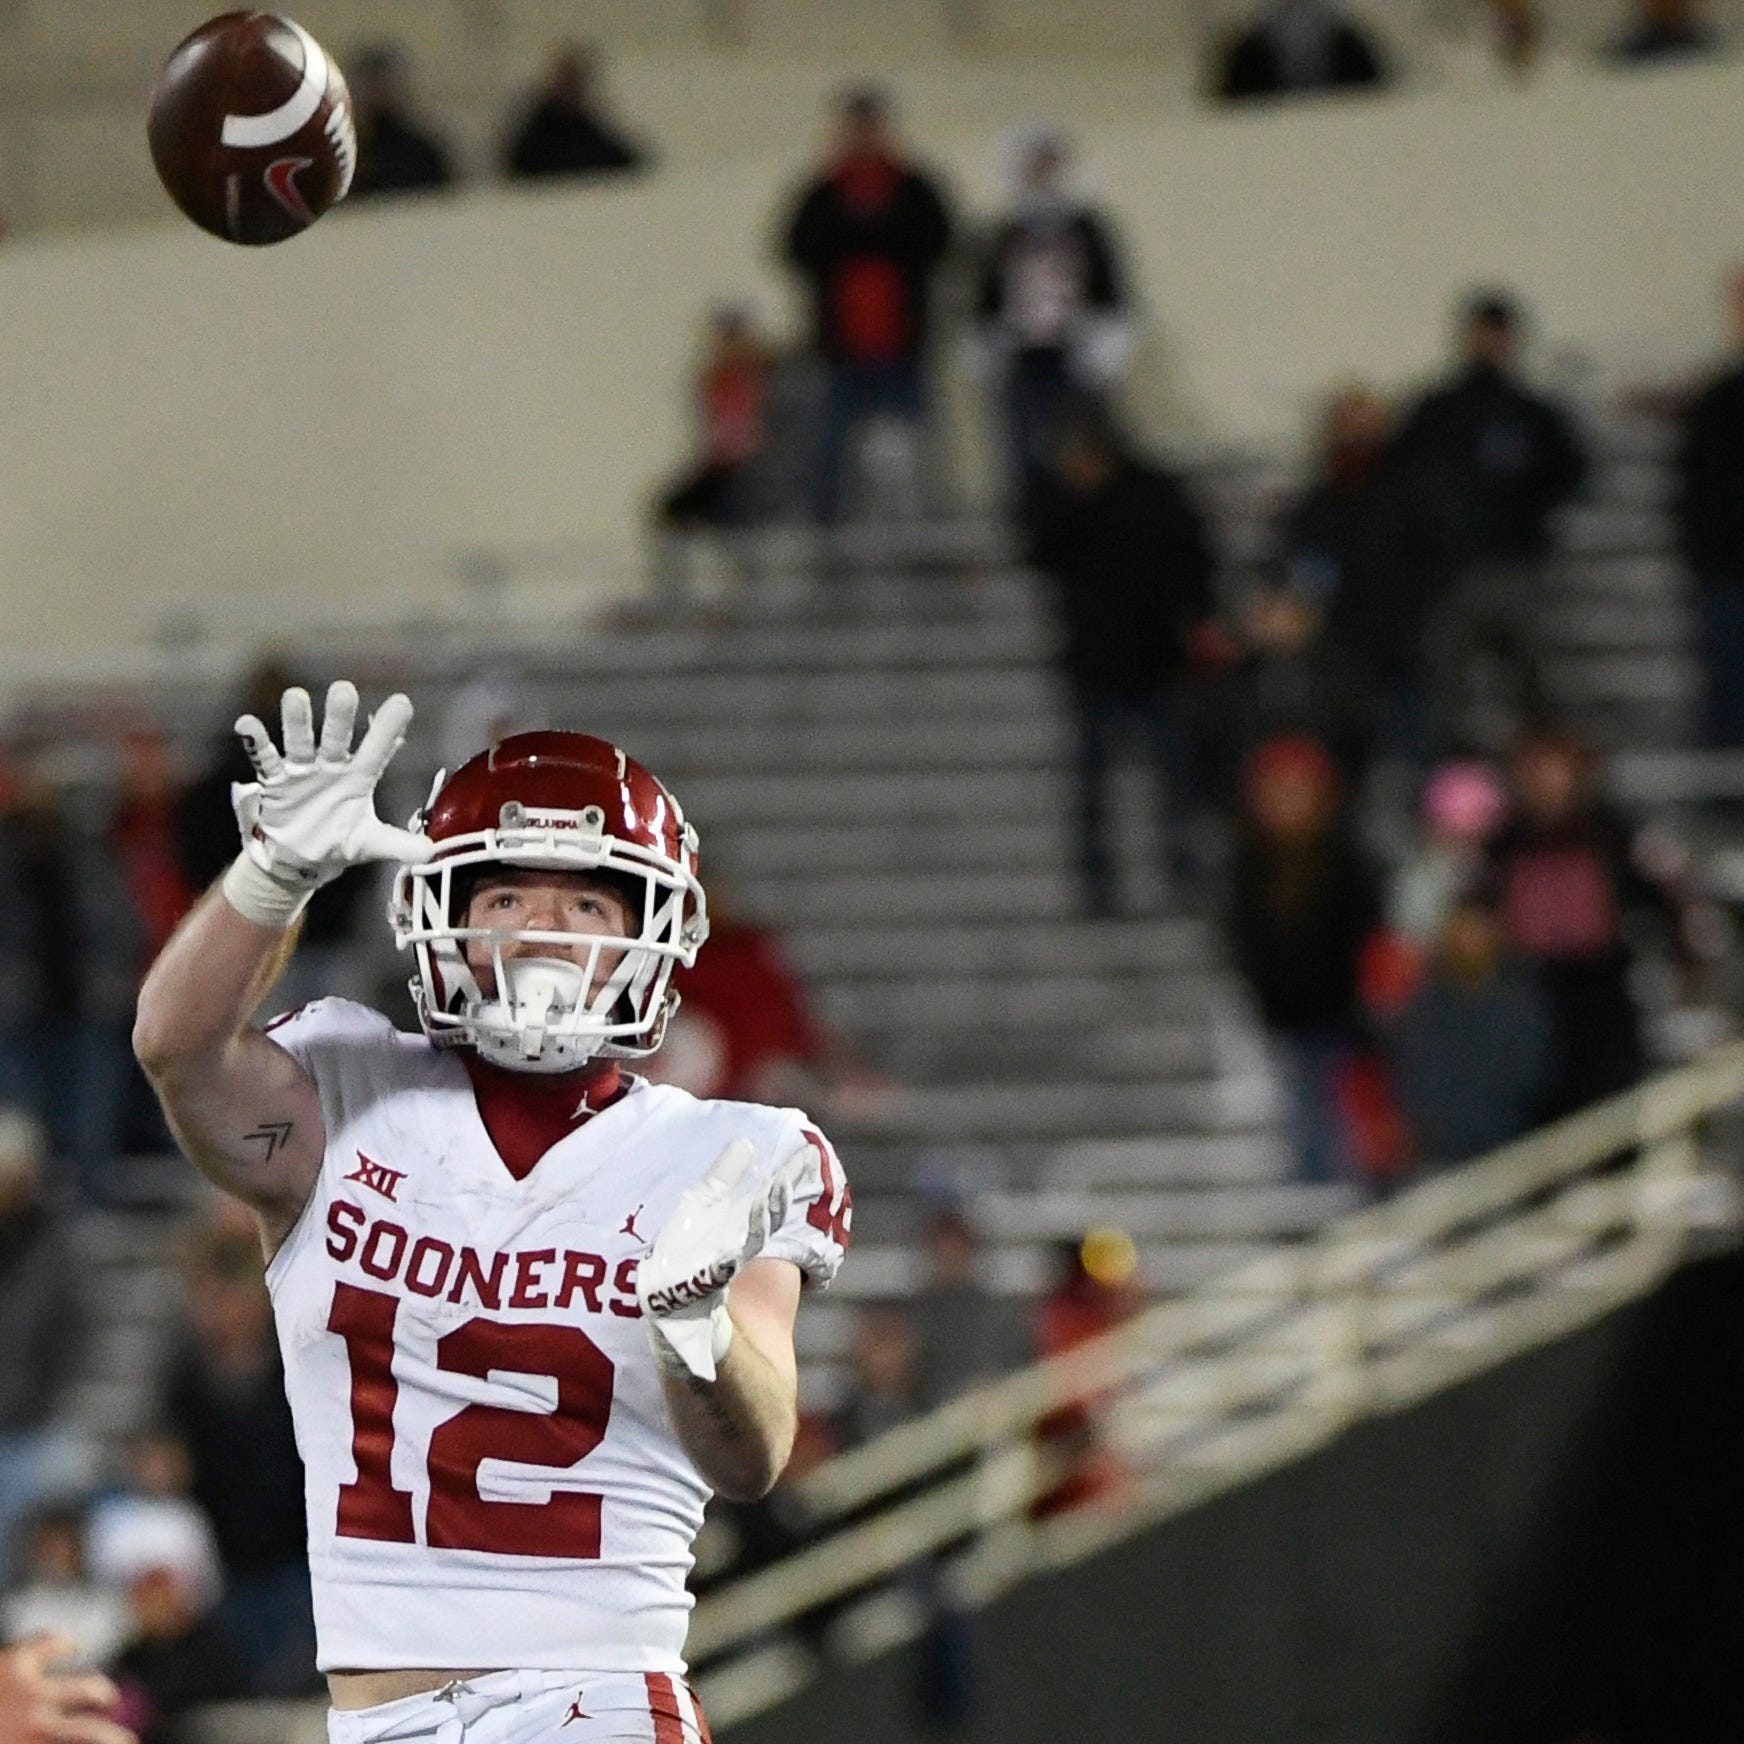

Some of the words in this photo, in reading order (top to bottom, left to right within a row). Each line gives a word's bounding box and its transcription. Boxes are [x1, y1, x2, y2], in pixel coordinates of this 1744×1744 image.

[343, 1148, 408, 1203] XII
[325, 1199, 645, 1319] SOONERS
[326, 1280, 615, 1559] 12
